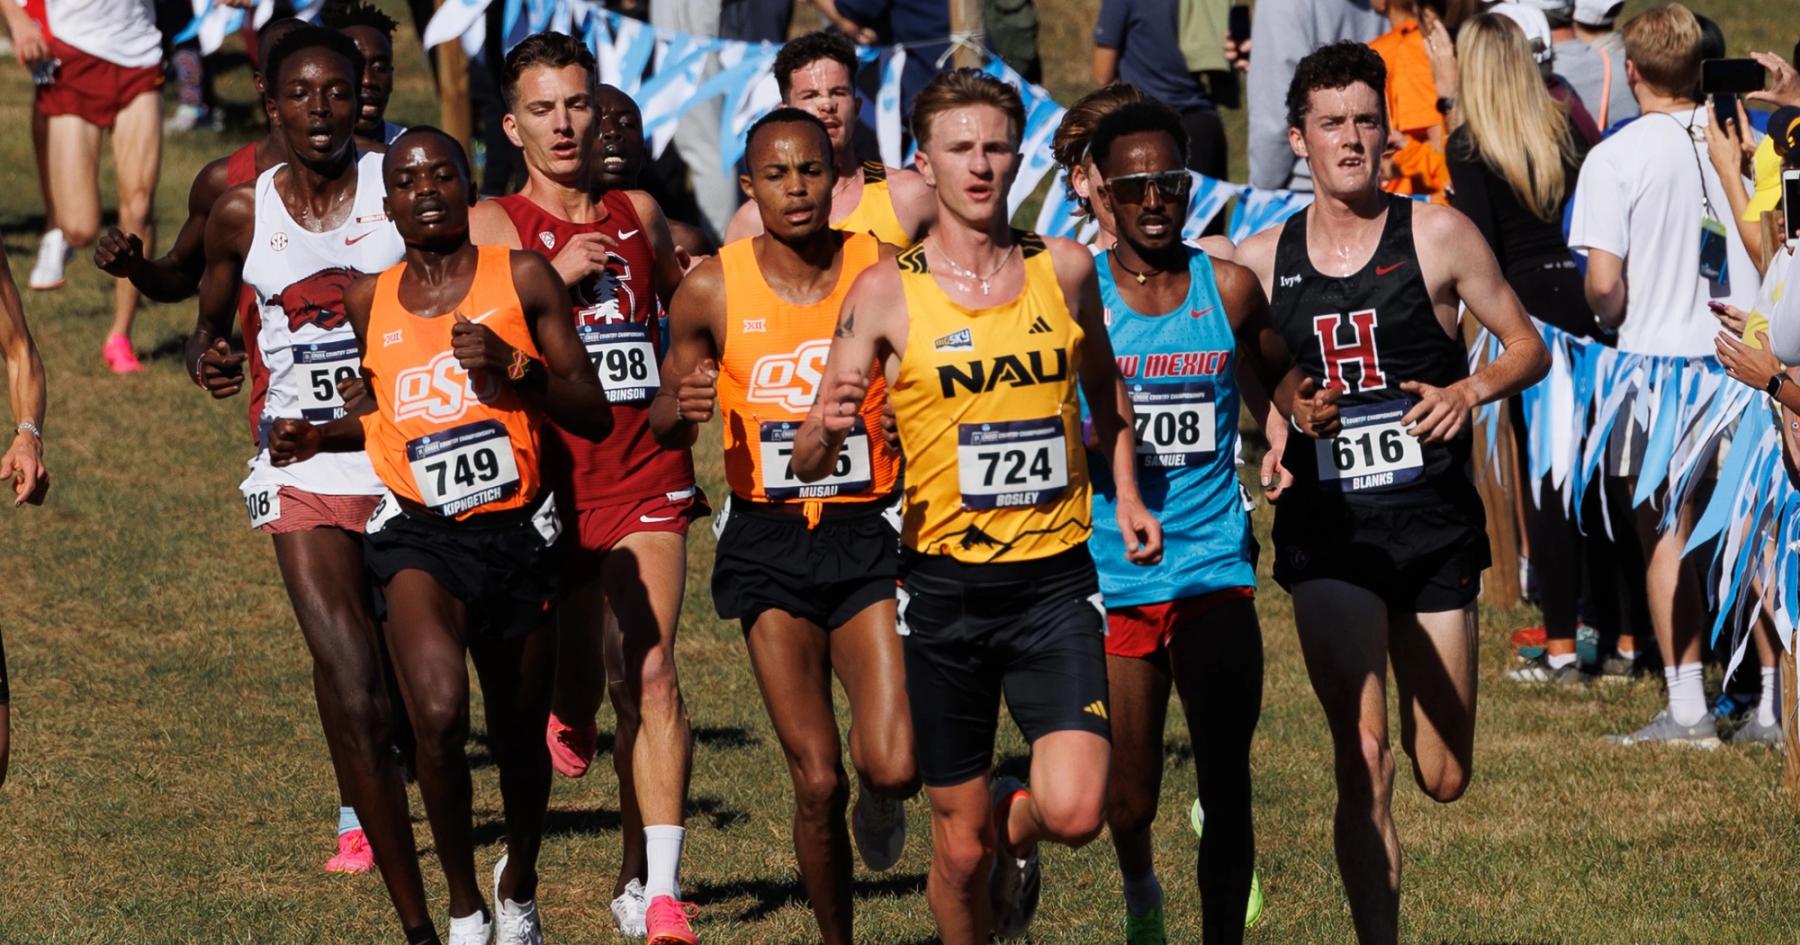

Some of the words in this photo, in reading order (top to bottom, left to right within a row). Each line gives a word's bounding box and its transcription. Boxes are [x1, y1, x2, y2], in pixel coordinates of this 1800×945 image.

[1313, 308, 1388, 395] H
[936, 348, 1068, 399] NAU
[1134, 411, 1201, 447] 708
[978, 447, 1053, 486] 724
[1144, 453, 1187, 467] SAMUEL
[1332, 429, 1404, 471] 616
[425, 448, 500, 497] 749
[1353, 472, 1394, 490] BLANKS
[443, 486, 502, 517] KIPNGETICH
[799, 485, 839, 498] MUSAU
[996, 491, 1040, 507] BOSLEY
